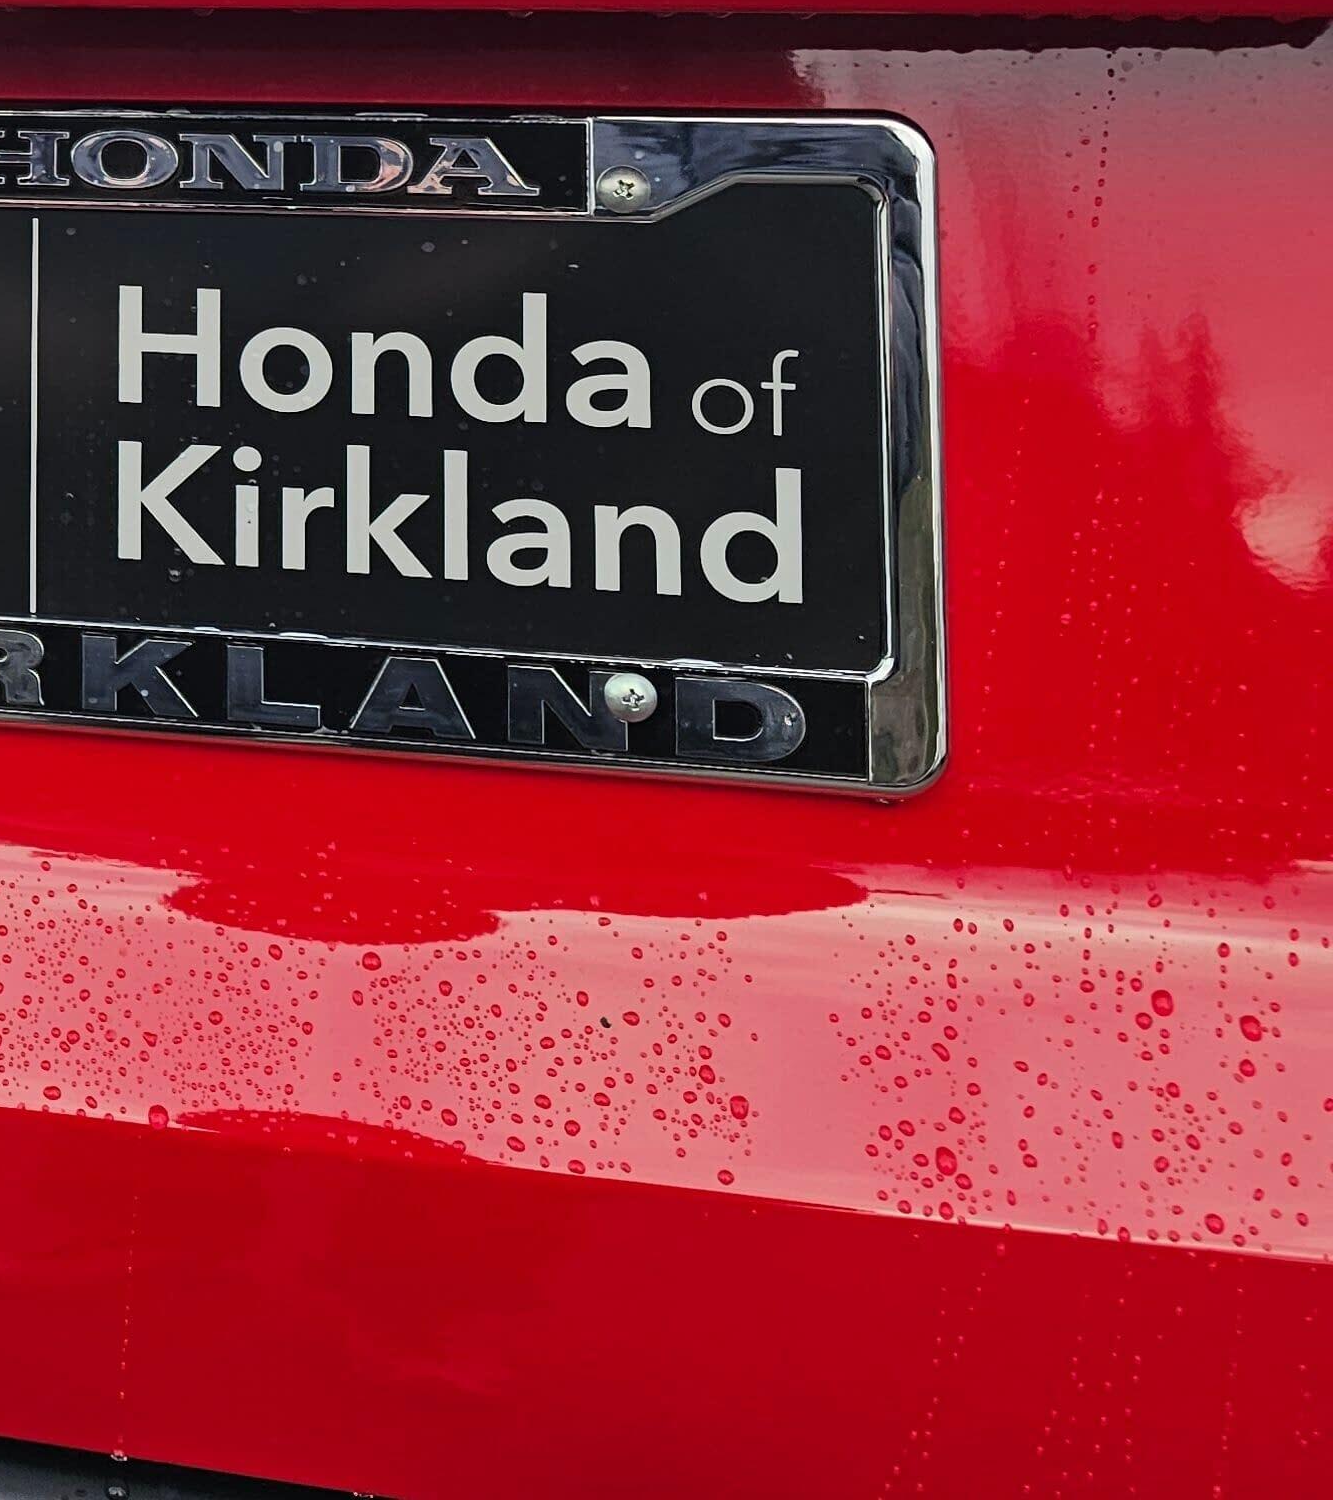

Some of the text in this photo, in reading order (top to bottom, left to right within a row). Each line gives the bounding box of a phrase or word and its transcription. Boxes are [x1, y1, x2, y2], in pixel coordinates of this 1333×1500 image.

[116, 284, 800, 437] Honda of
[116, 440, 805, 606] Kirkland
